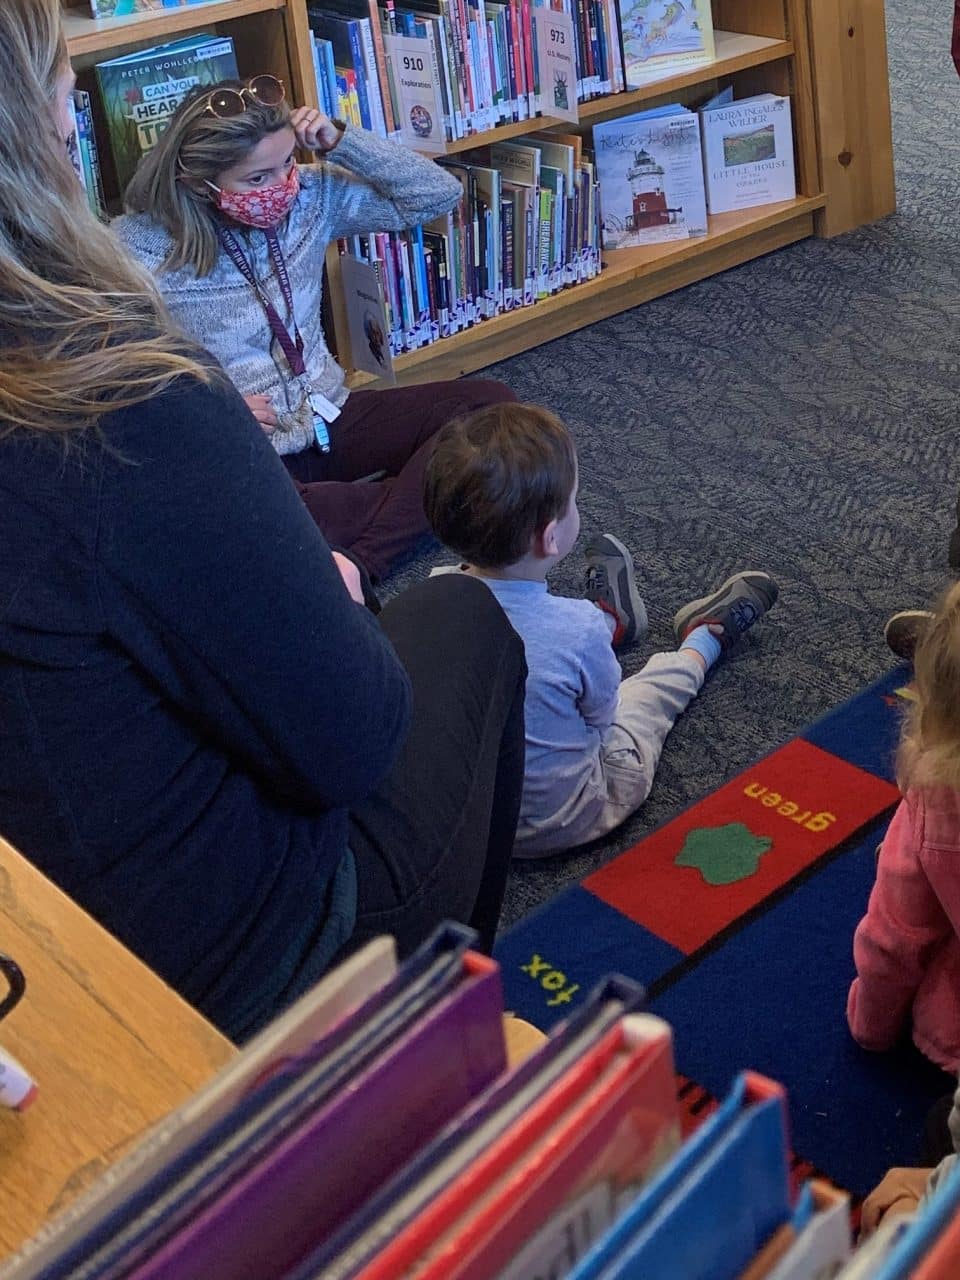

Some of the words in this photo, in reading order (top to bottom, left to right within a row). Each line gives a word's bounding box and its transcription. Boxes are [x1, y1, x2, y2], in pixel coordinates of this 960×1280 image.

[550, 30, 565, 44] 973
[404, 57, 424, 71] 910
[122, 67, 150, 78] PETER
[145, 85, 170, 97] CAN
[173, 78, 196, 91] YOU
[401, 79, 431, 89] Exploration
[137, 100, 178, 119] HEAR
[709, 110, 742, 123] LAURA
[728, 115, 768, 128] WILDER
[713, 167, 750, 180] LITTLE
[753, 160, 788, 172] HOUSE
[743, 781, 838, 833] green
[520, 953, 580, 1007] fox
